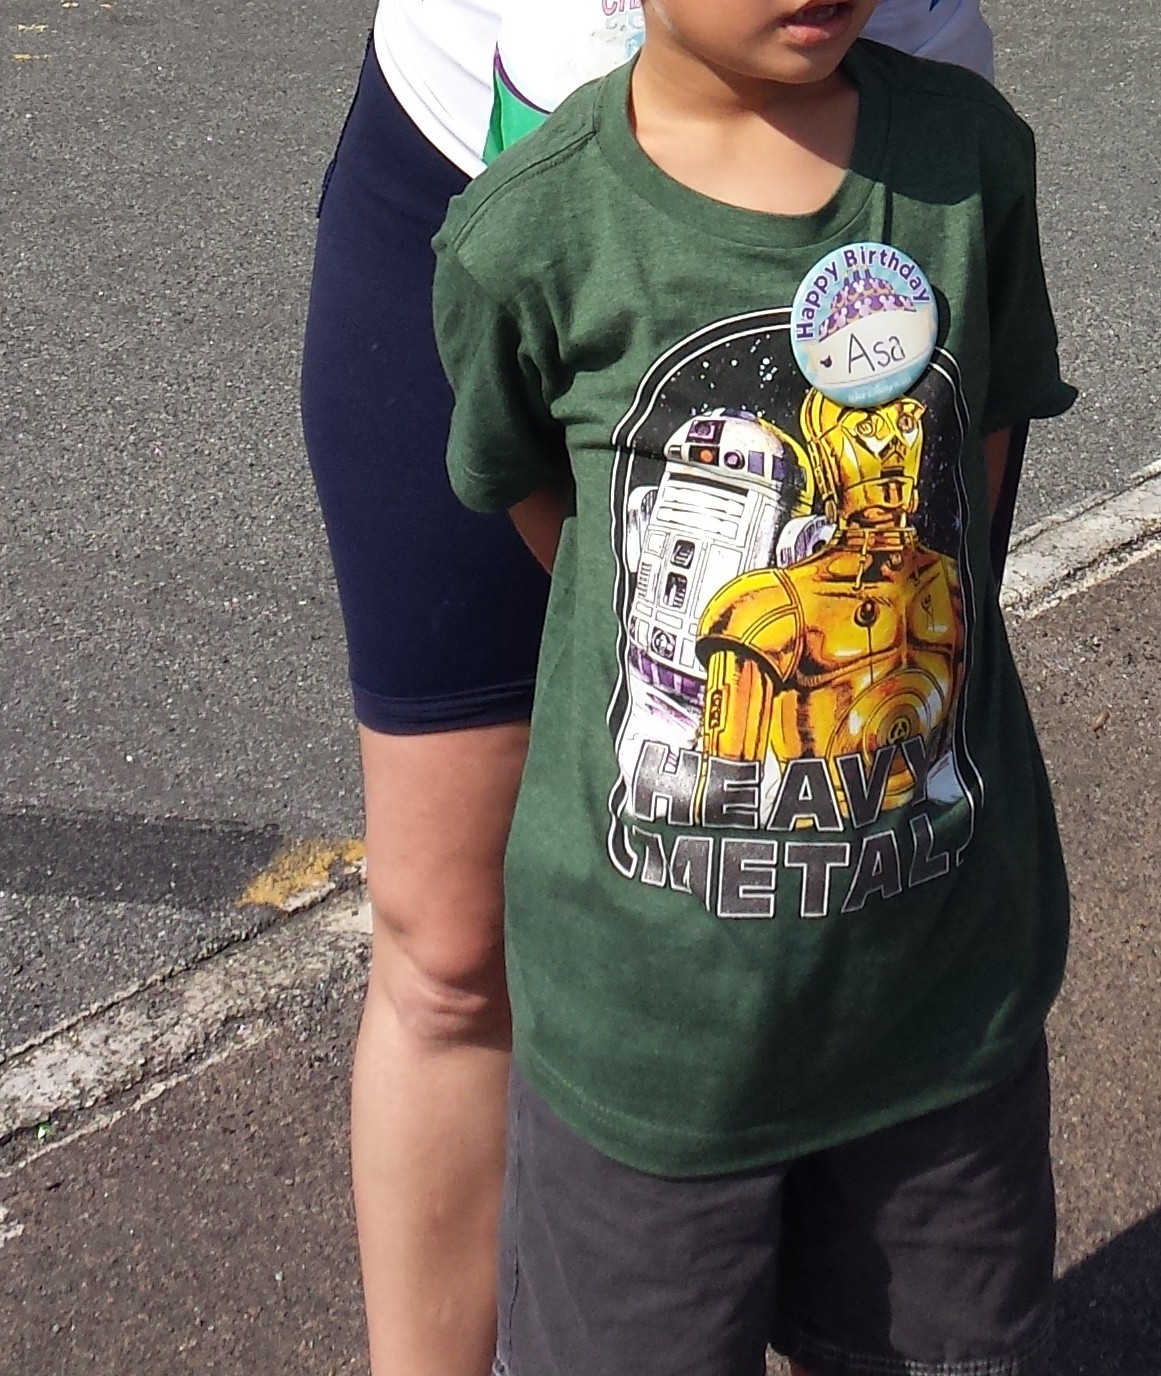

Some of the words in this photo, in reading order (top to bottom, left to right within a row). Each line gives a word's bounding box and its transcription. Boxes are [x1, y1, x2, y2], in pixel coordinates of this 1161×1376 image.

[796, 261, 838, 339] Happy
[844, 246, 930, 302] Birthday
[848, 332, 906, 374] Asa
[632, 728, 948, 832] HEAVY
[632, 813, 950, 919] METAL
